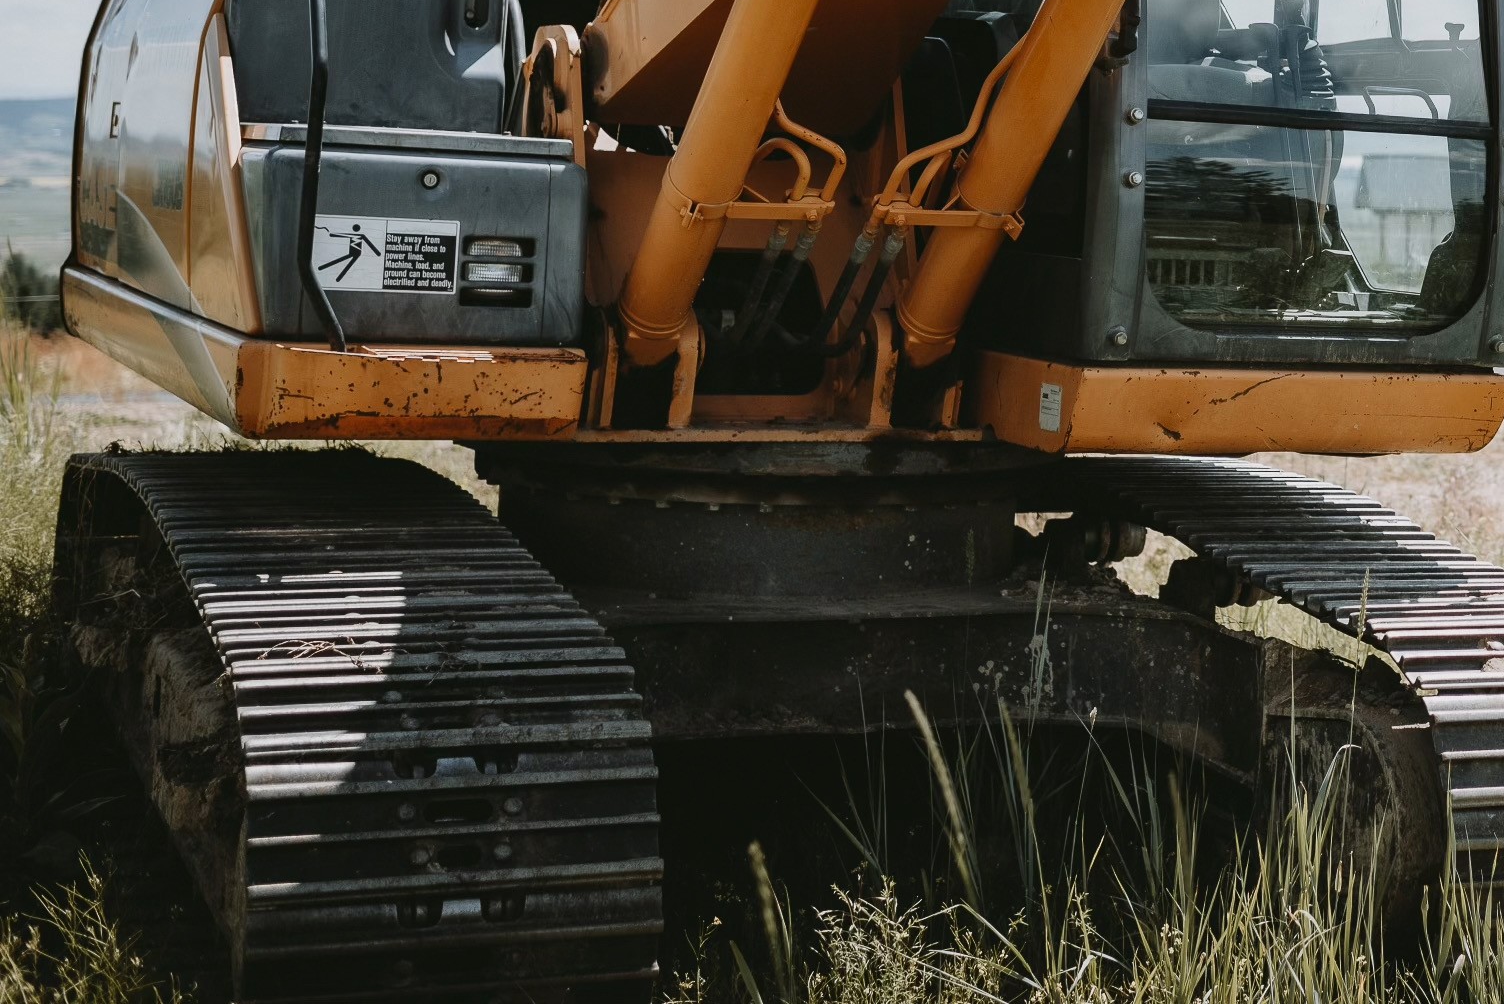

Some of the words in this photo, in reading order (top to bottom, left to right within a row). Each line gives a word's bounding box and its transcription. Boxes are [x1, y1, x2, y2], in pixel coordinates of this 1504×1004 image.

[386, 234, 402, 243] Stay
[404, 236, 422, 244] away
[424, 236, 440, 244] from
[386, 244, 413, 252] machine
[415, 244, 420, 252] if
[421, 244, 438, 252] close
[440, 245, 446, 253] to
[407, 252, 424, 260] lines.
[432, 262, 445, 270] and
[384, 269, 407, 278] ground
[422, 270, 446, 279] become
[383, 278, 415, 286] electrified
[417, 279, 430, 287] and
[431, 279, 453, 288] deadly.
